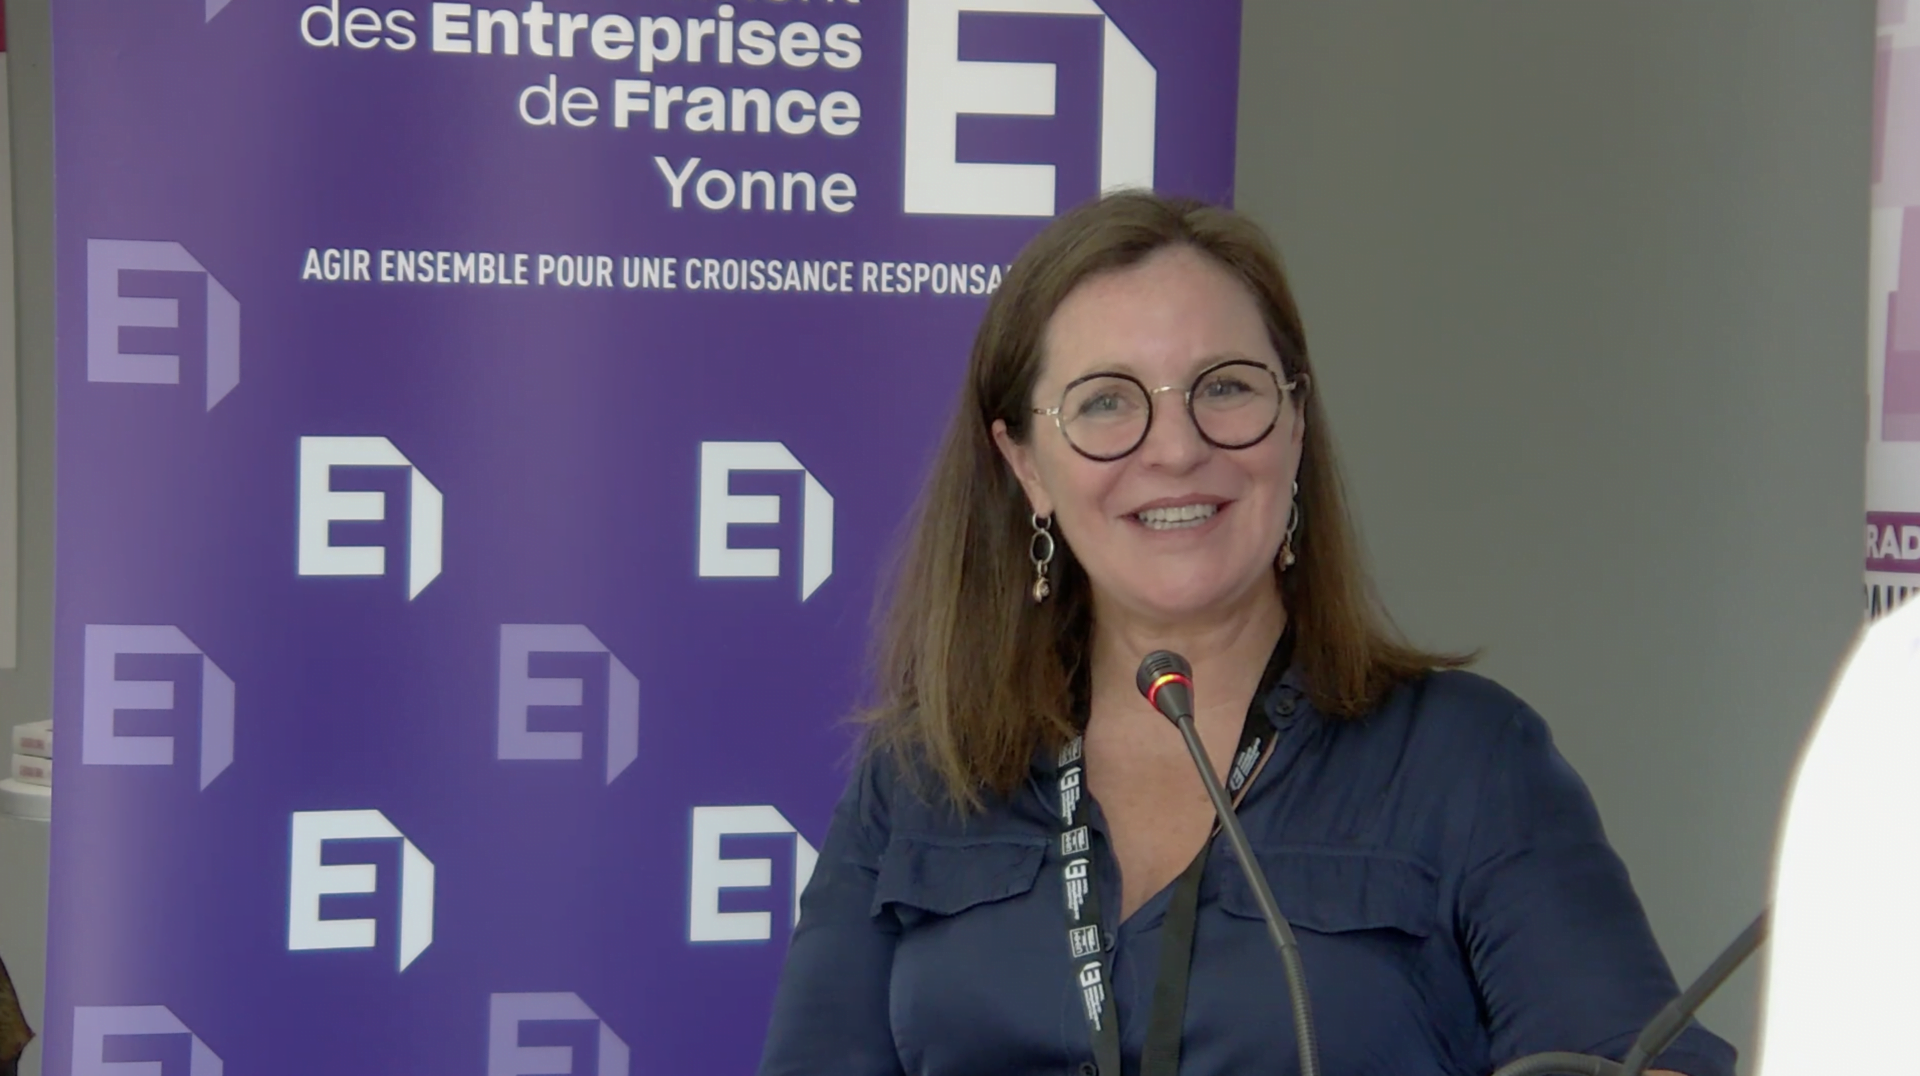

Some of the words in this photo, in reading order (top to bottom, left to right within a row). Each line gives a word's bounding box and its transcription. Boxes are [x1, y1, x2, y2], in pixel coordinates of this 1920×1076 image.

[300, 0, 417, 51] des
[432, 1, 862, 73] Entreprises
[518, 73, 599, 128] de
[614, 79, 861, 136] France
[654, 156, 857, 213] Yonne
[302, 248, 371, 281] AGIR
[380, 250, 528, 286] ENSEMBLE
[537, 254, 613, 288] POUR
[622, 257, 676, 289] UNE
[685, 258, 853, 292] CROISSANCE
[862, 261, 1011, 295] RESPONSA
